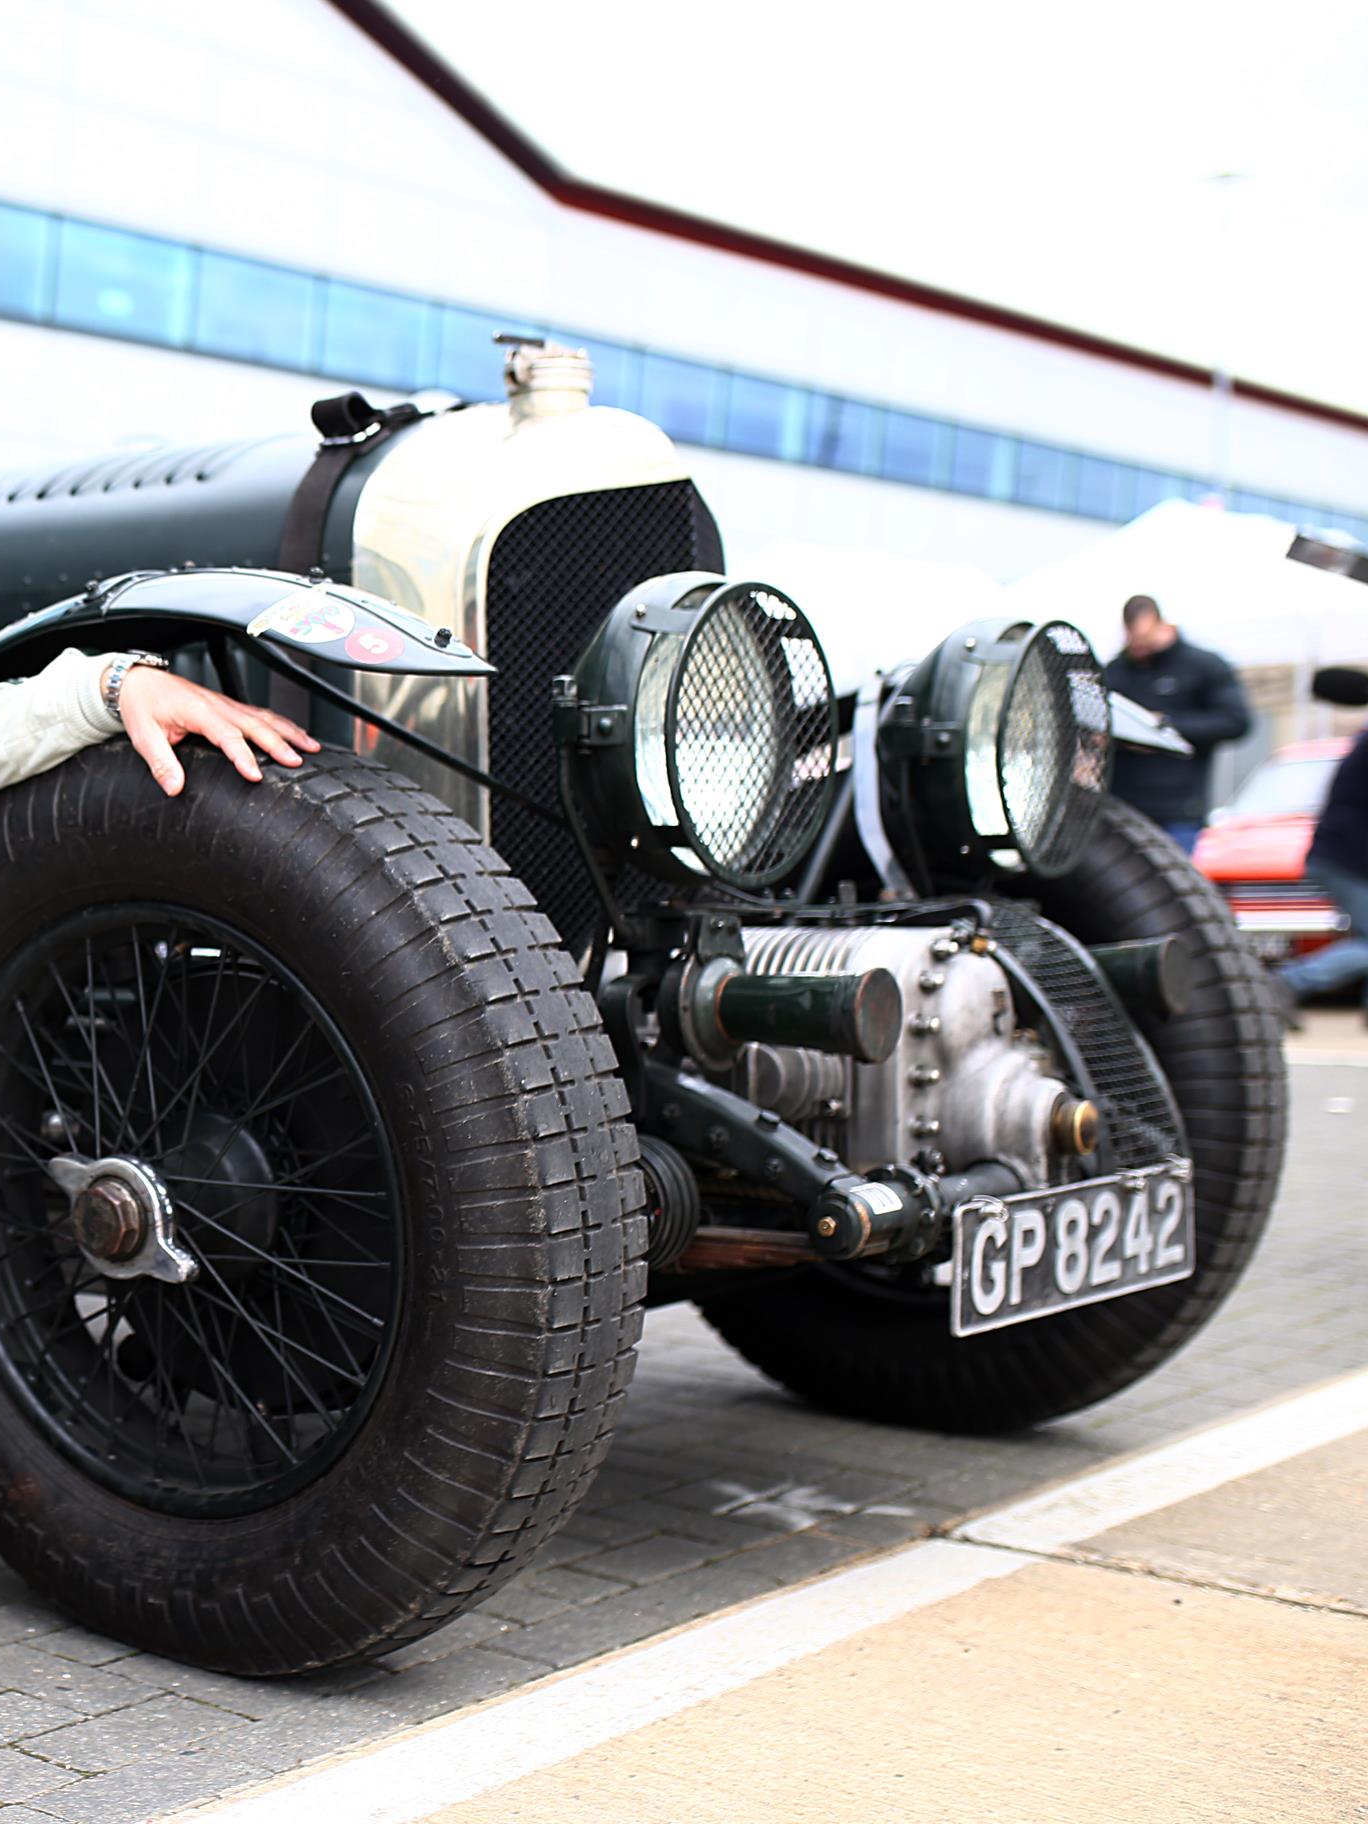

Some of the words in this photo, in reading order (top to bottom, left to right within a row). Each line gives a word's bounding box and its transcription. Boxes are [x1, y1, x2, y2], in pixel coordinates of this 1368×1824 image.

[358, 632, 389, 655] 5
[971, 1209, 1046, 1315] GP
[1055, 1179, 1185, 1295] 8242
